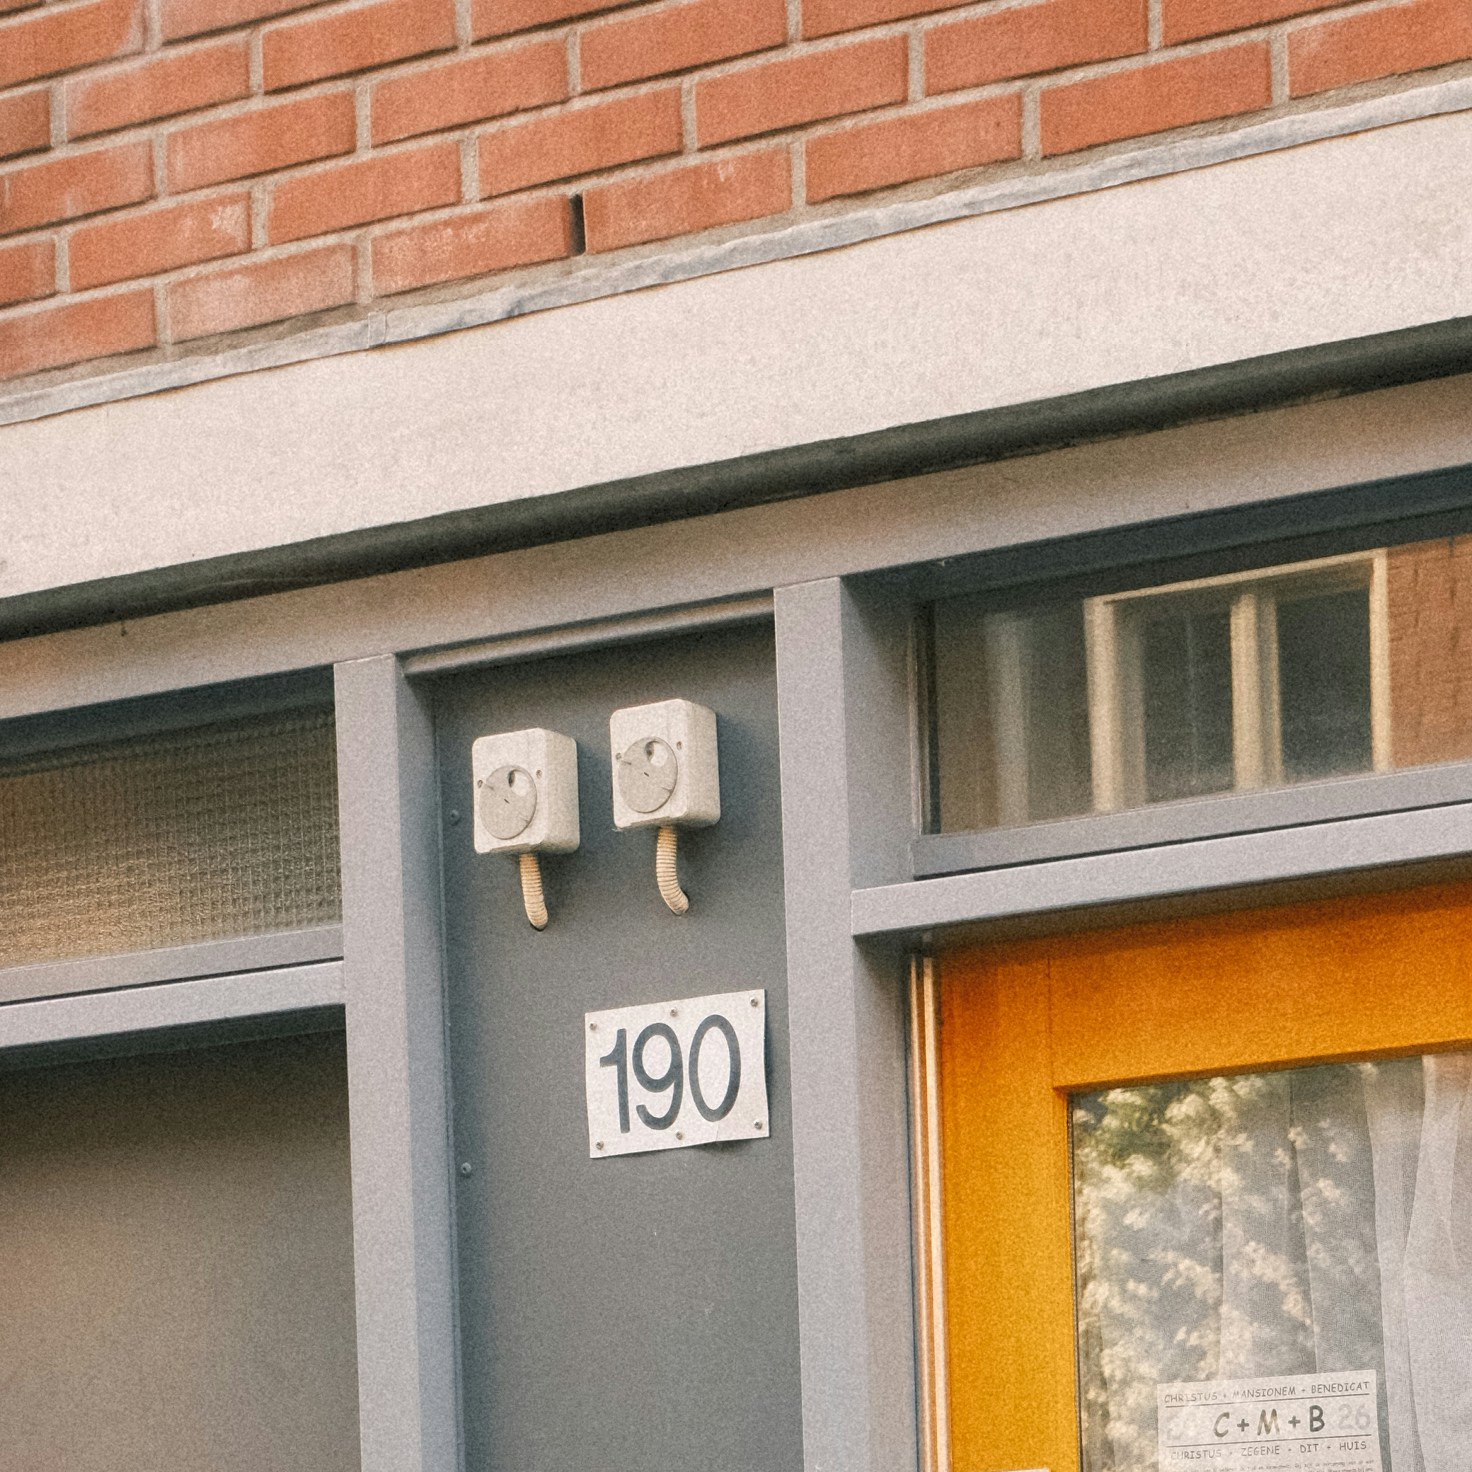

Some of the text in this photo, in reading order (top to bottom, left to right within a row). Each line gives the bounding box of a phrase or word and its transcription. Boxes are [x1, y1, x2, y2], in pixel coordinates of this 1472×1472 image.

[599, 1014, 741, 1134] 190
[1164, 1391, 1218, 1403] CHRISTUS
[1233, 1386, 1296, 1398] MANSIONEM
[1311, 1381, 1370, 1394] BENEDICAT
[1337, 1402, 1372, 1431] 26
[1171, 1448, 1222, 1461] CHRISTUS
[1241, 1445, 1280, 1457] ZEGENE
[1300, 1443, 1319, 1454] DIT
[1339, 1440, 1367, 1451] HUIS
